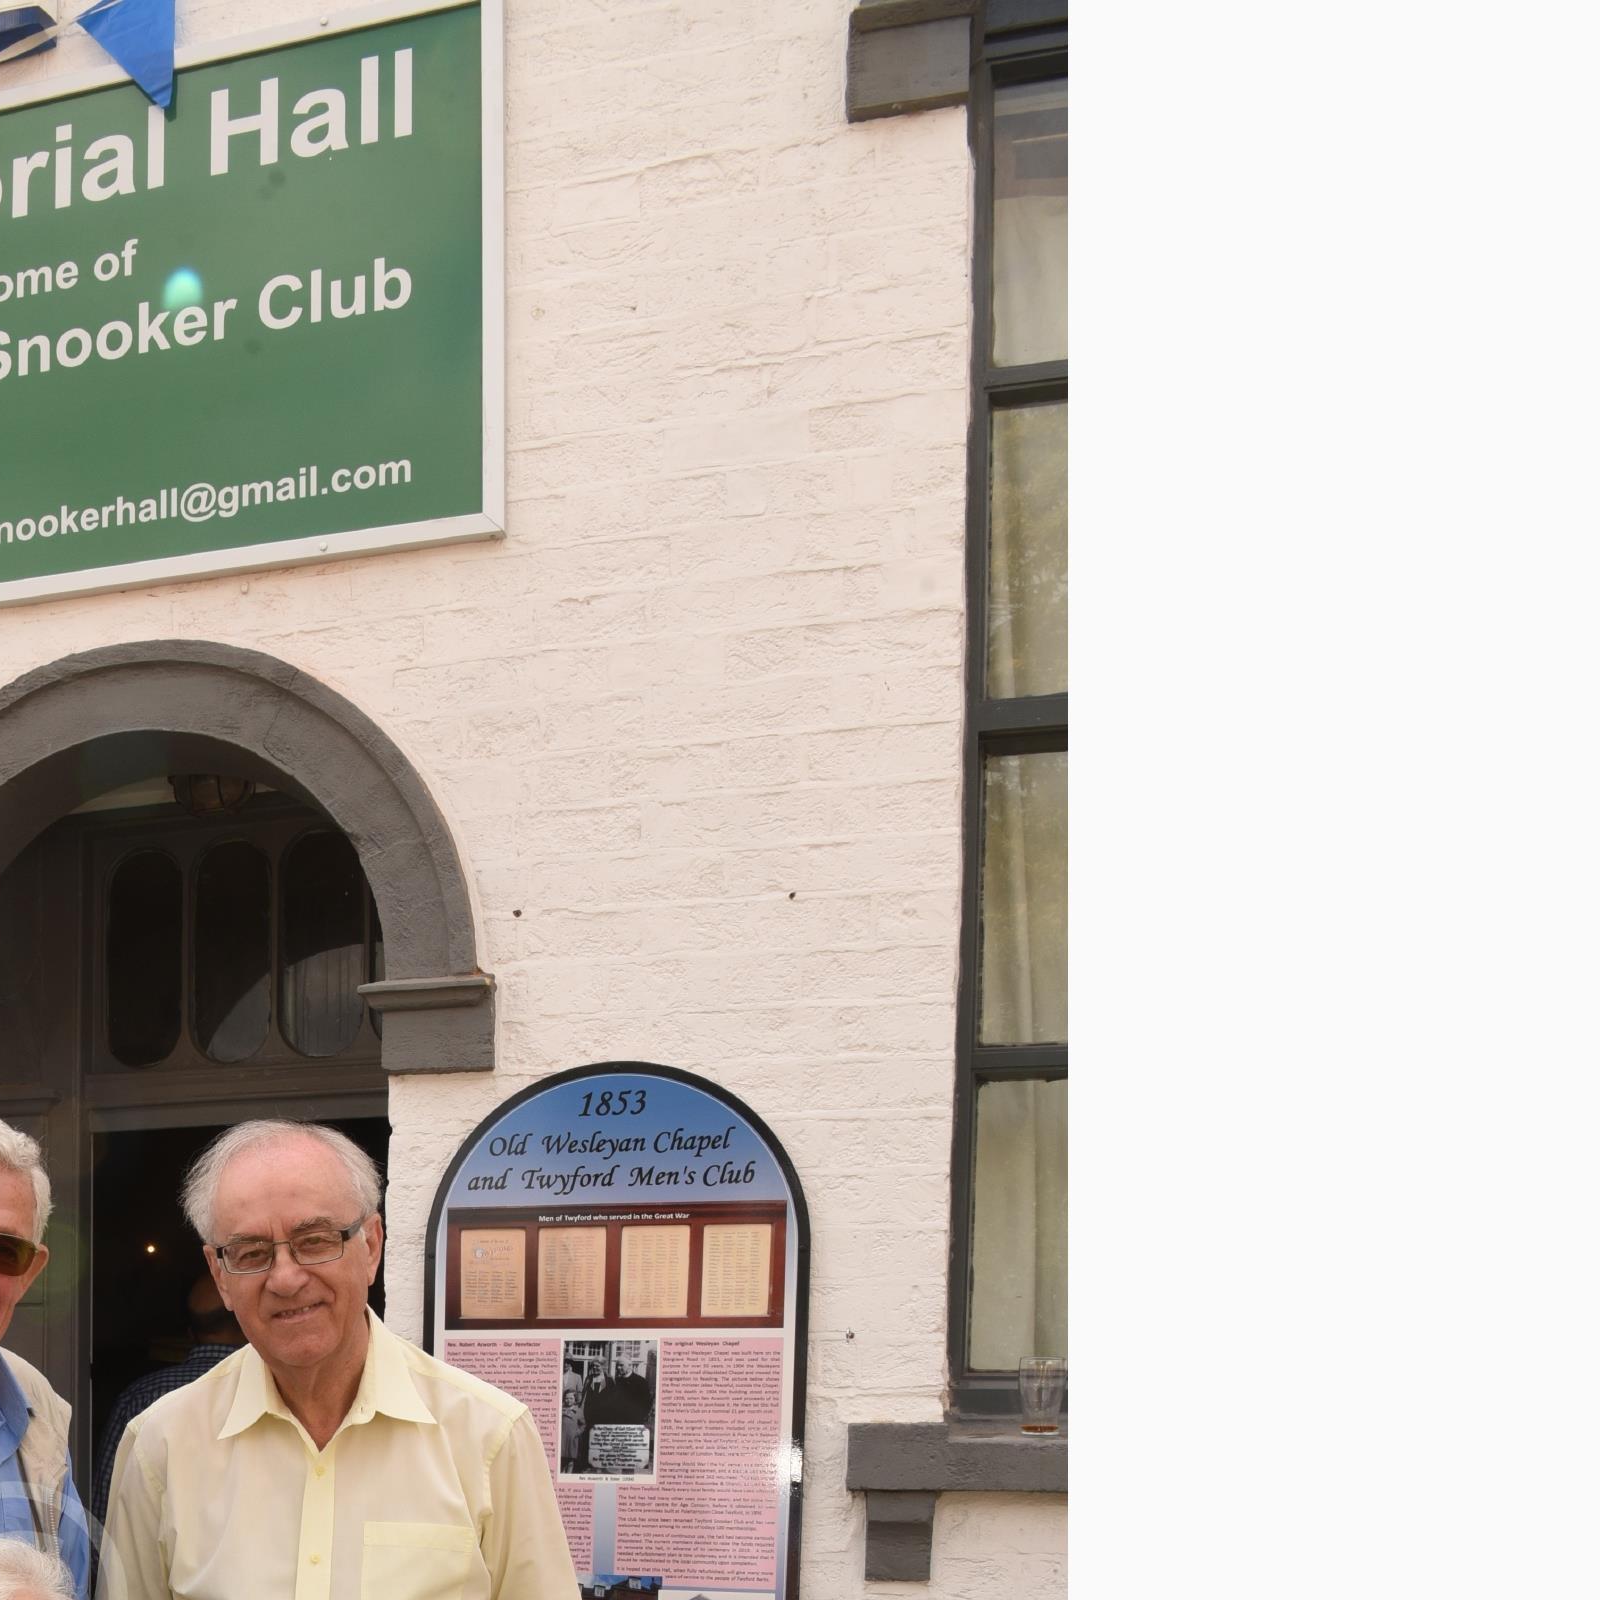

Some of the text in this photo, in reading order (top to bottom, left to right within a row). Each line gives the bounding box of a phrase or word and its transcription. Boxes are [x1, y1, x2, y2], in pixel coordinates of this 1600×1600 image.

[210, 49, 413, 176] Hall
[94, 239, 138, 281] of
[259, 258, 412, 329] Club
[579, 1089, 647, 1117] 1853
[489, 1126, 736, 1160] Old Wesleyan Chapel
[467, 1160, 756, 1196] and Twyford Men's Club
[565, 1214, 591, 1223] Twyford
